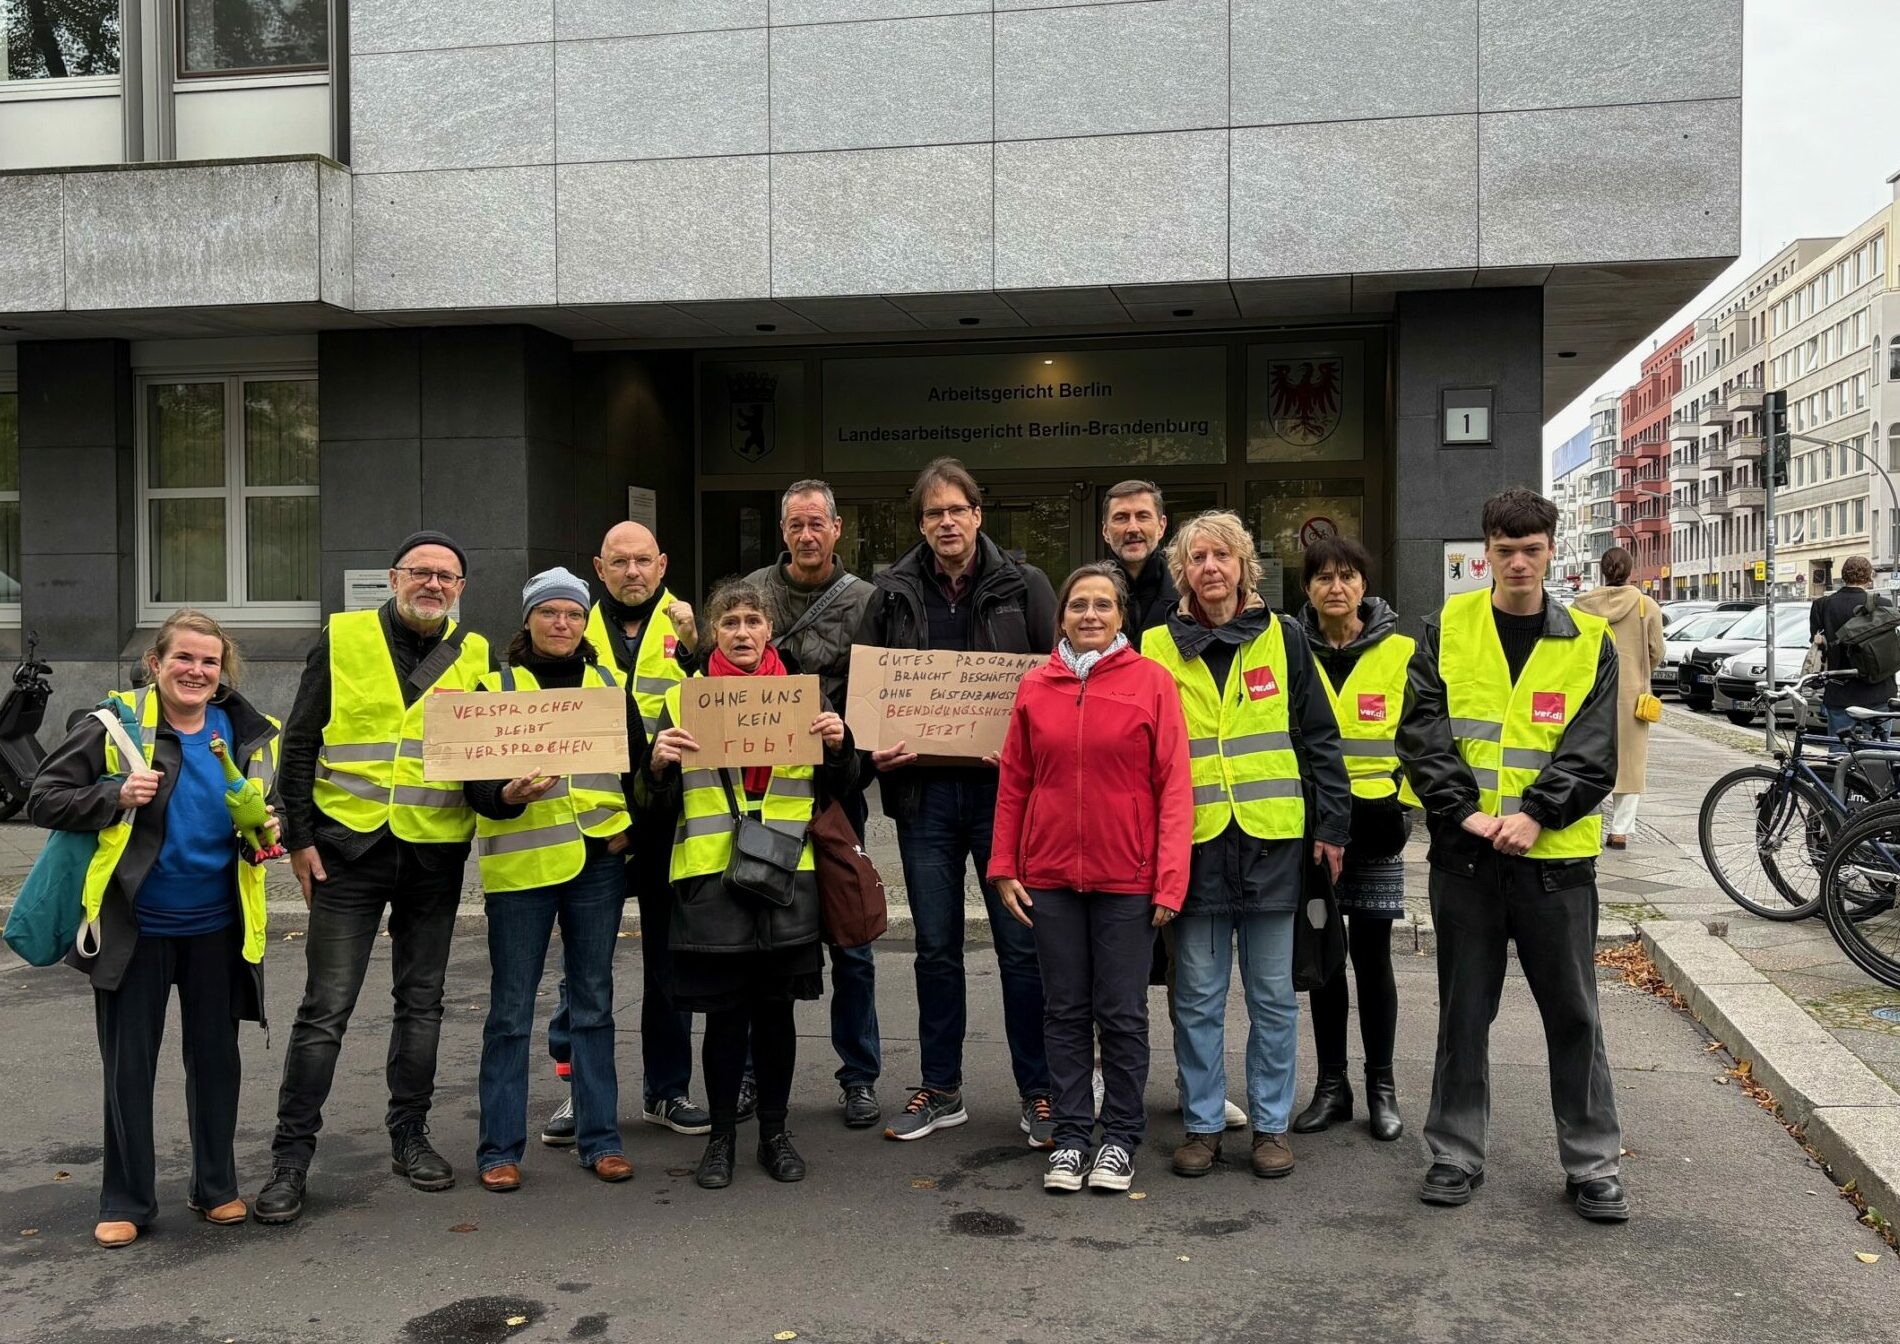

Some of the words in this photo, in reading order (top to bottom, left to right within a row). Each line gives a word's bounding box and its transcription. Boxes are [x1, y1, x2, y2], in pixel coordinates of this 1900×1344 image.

[928, 382, 1053, 403] Arbeitsgericht
[1058, 381, 1112, 399] Berlin
[838, 420, 1022, 442] Landesarbeitsgericht
[1028, 418, 1209, 438] Berlin-Brandenburg
[1463, 413, 1470, 434] 1
[879, 652, 935, 667] GUTES
[894, 670, 951, 682] BRAUCHT
[879, 688, 912, 700] OHNE
[1249, 681, 1276, 693] ver.di
[699, 689, 747, 709] OHNE
[762, 688, 803, 704] UNS
[453, 700, 584, 720] VERSPROCHEN
[1360, 708, 1384, 719] ver.di
[1534, 709, 1563, 721] ver.di
